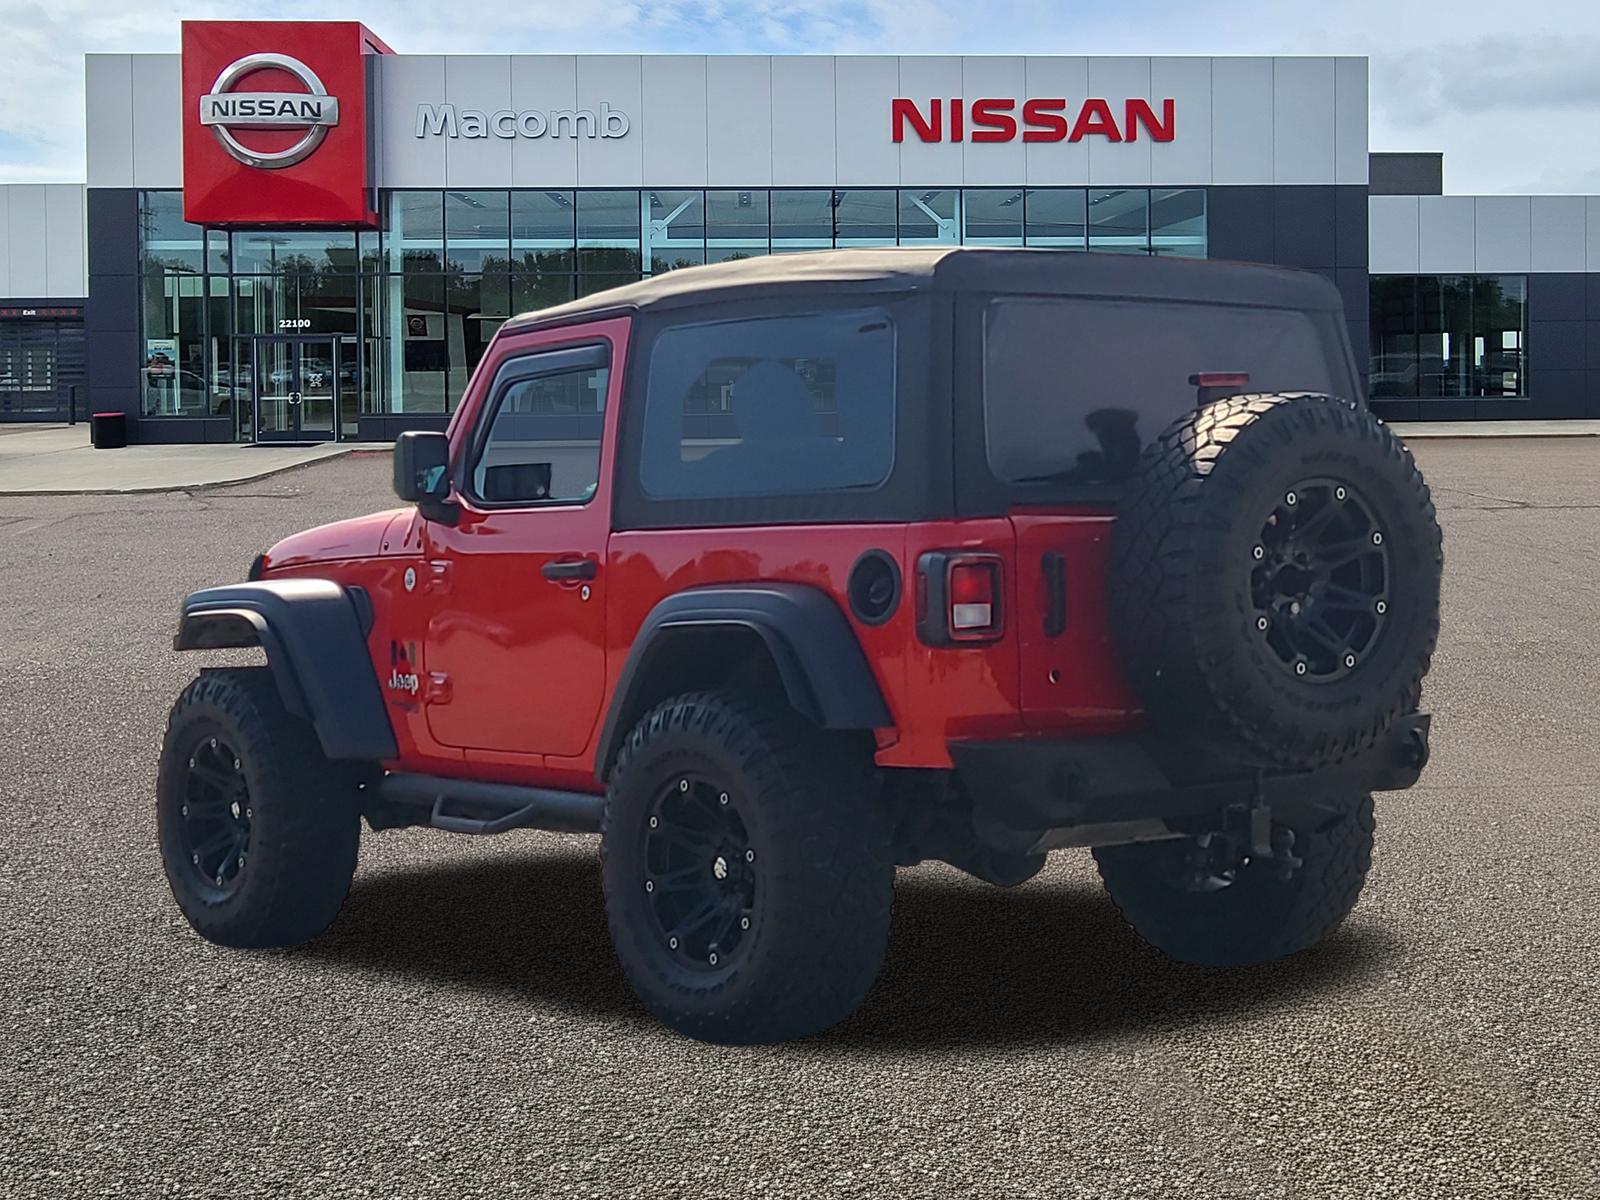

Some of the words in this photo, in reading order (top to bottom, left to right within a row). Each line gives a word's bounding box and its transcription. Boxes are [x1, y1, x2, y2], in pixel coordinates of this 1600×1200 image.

[211, 100, 322, 117] NISSAN
[415, 102, 630, 138] Macomb
[892, 98, 1175, 143] NISSAN
[279, 319, 311, 328] 22100
[388, 668, 419, 696] Jeep
